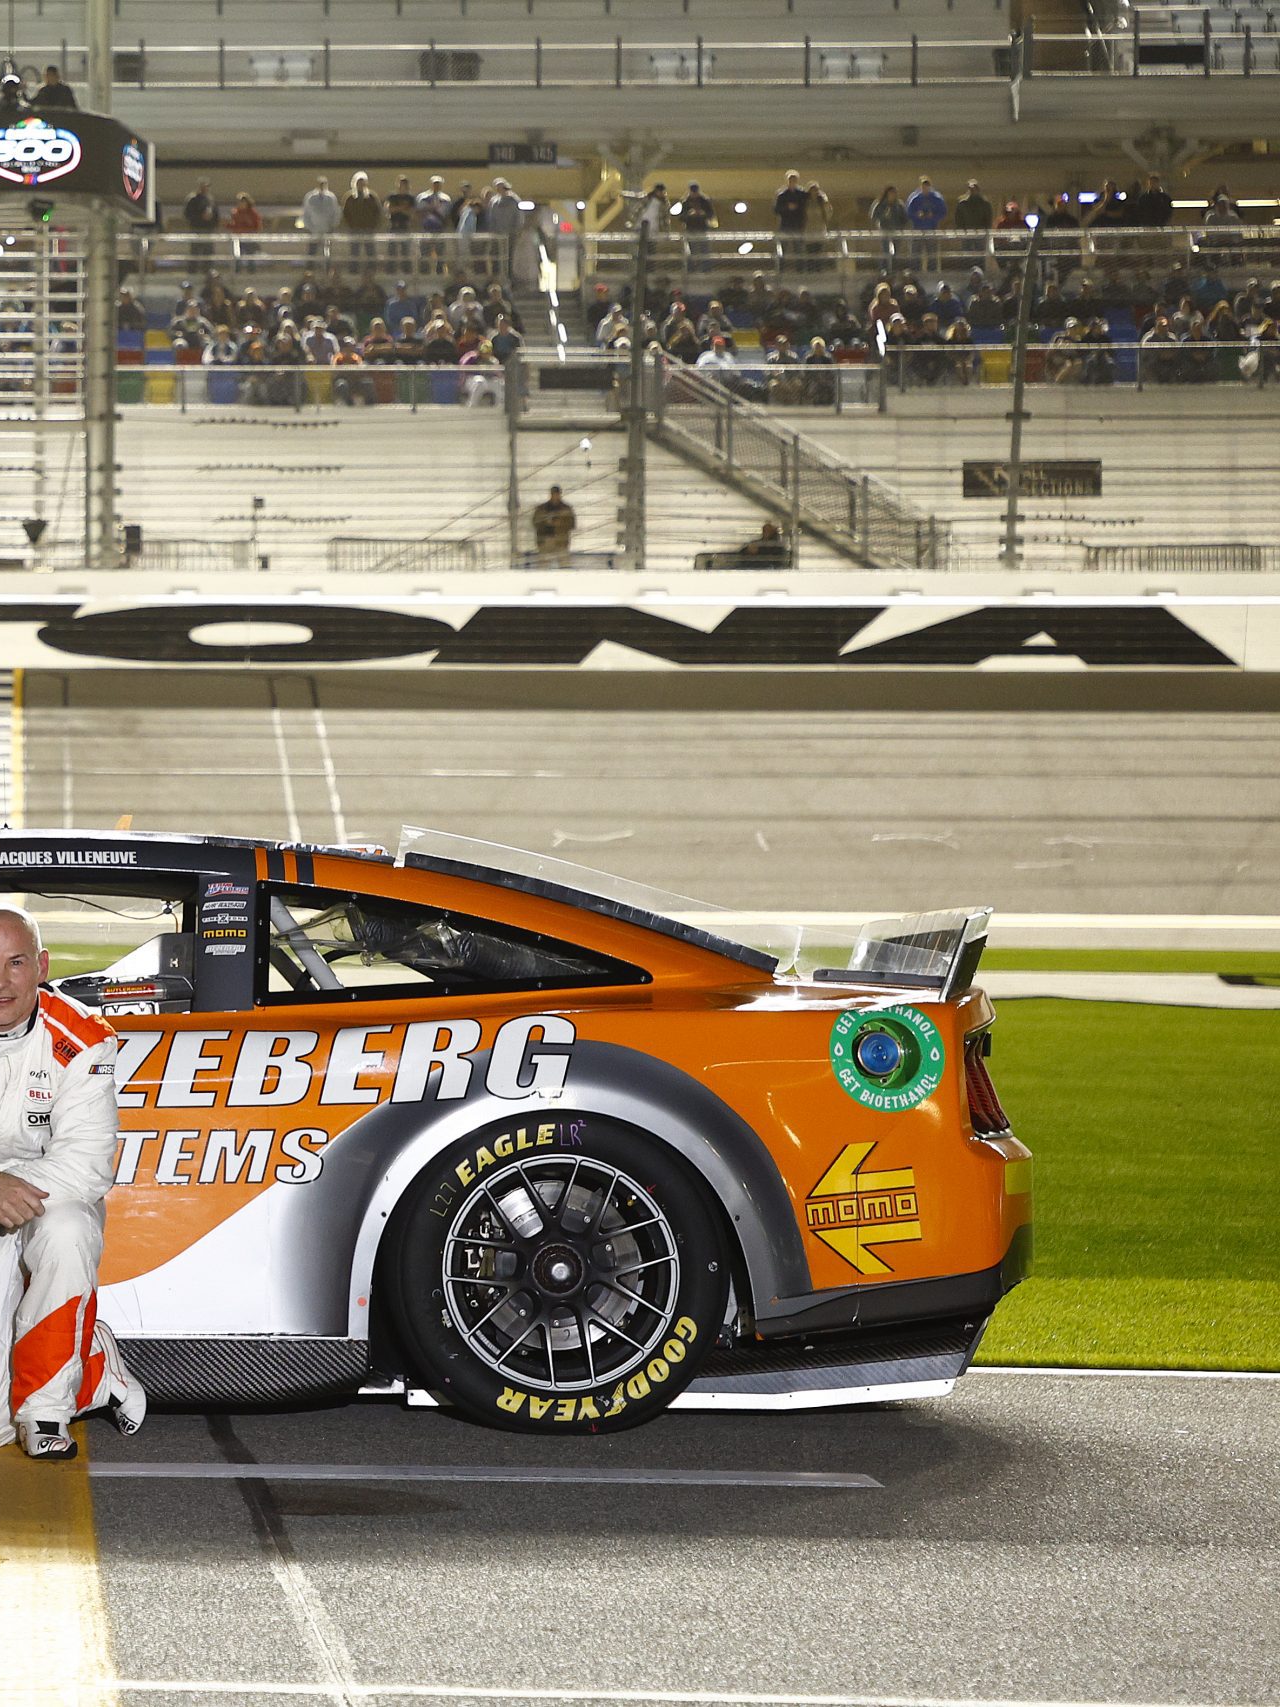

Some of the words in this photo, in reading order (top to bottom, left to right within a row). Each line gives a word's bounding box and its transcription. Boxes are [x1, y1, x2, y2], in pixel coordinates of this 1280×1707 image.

[56, 851, 138, 865] VILLENEUVE
[836, 1012, 856, 1035] GET
[55, 1041, 77, 1059] OMP
[116, 1014, 577, 1108] ZEBERG
[97, 1066, 115, 1074] NASC
[29, 1089, 53, 1099] BELL
[839, 1068, 861, 1092] GET
[860, 1073, 938, 1109] BIOETHANOL
[27, 1114, 51, 1124] OM
[115, 1128, 329, 1185] TEMS
[454, 1123, 556, 1187] EAGLE
[496, 1315, 698, 1422] GOODYEAR
